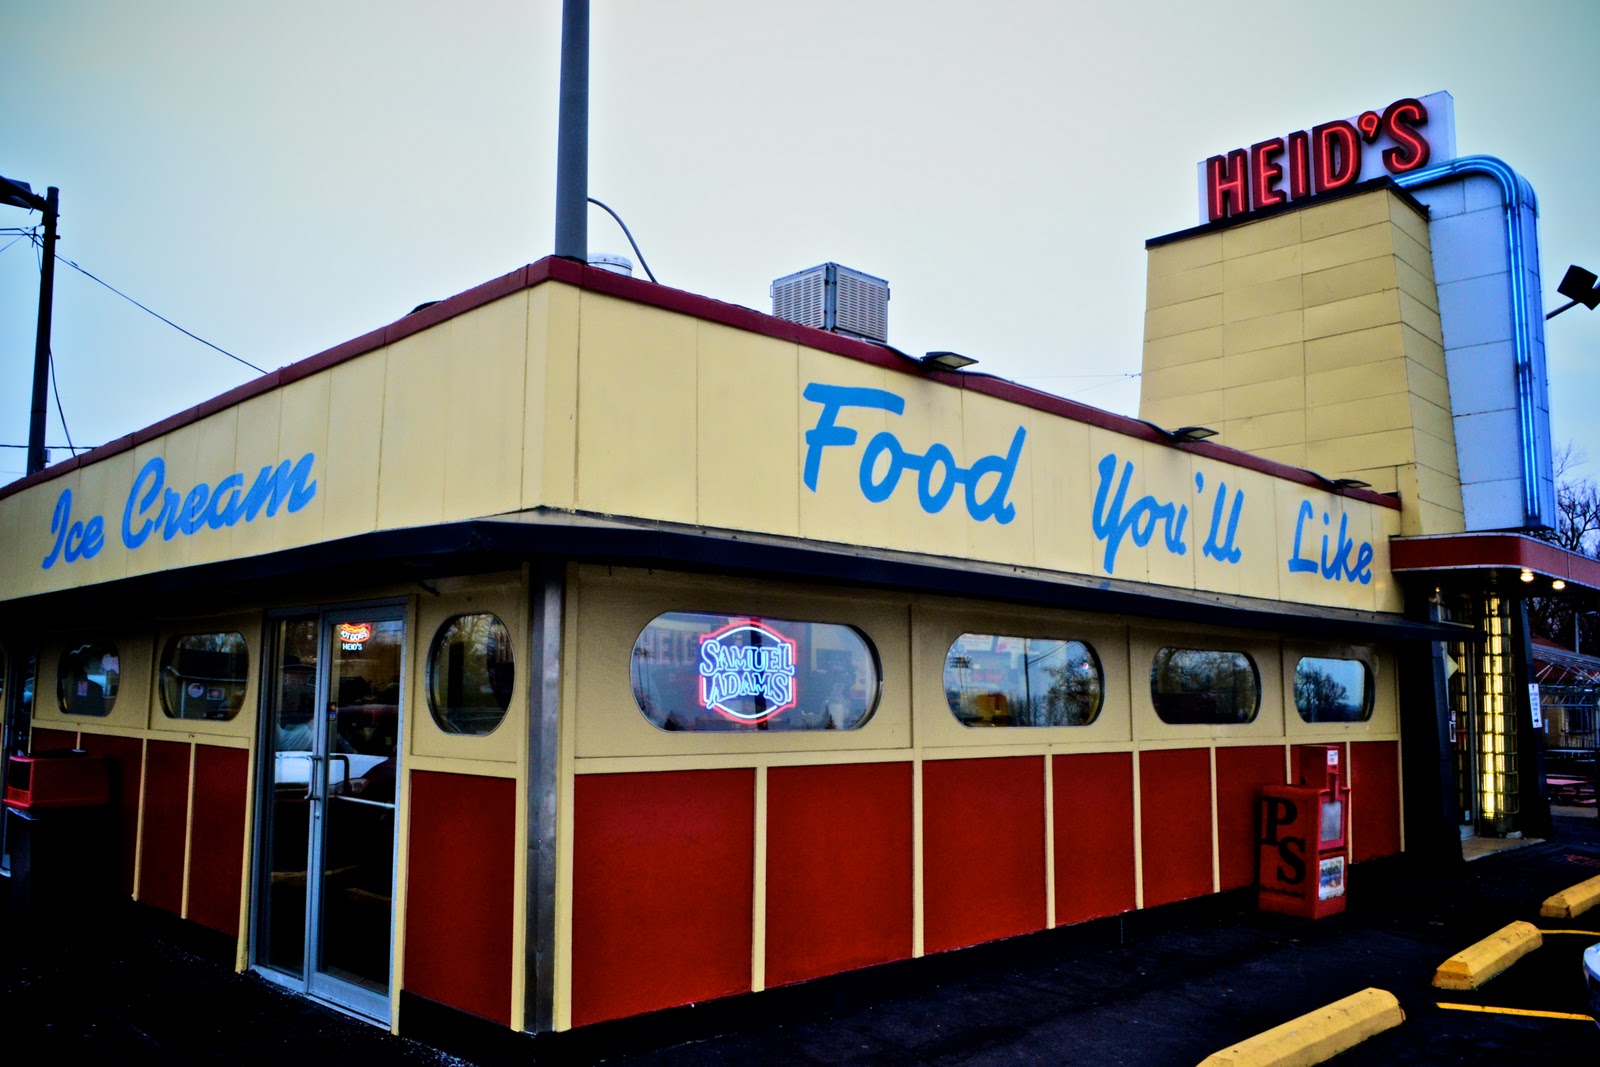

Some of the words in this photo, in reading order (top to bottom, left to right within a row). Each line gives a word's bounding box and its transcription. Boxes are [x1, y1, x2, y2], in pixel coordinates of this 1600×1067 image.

[1206, 98, 1431, 222] HEID'S
[42, 488, 105, 570] Ice
[121, 452, 317, 550] Cream
[803, 382, 1027, 525] Food
[1092, 453, 1244, 574] You'll
[1288, 500, 1374, 584] Like
[342, 642, 363, 651] HEID'S
[700, 639, 795, 677] SAMUEL
[706, 672, 790, 709] ADAMS
